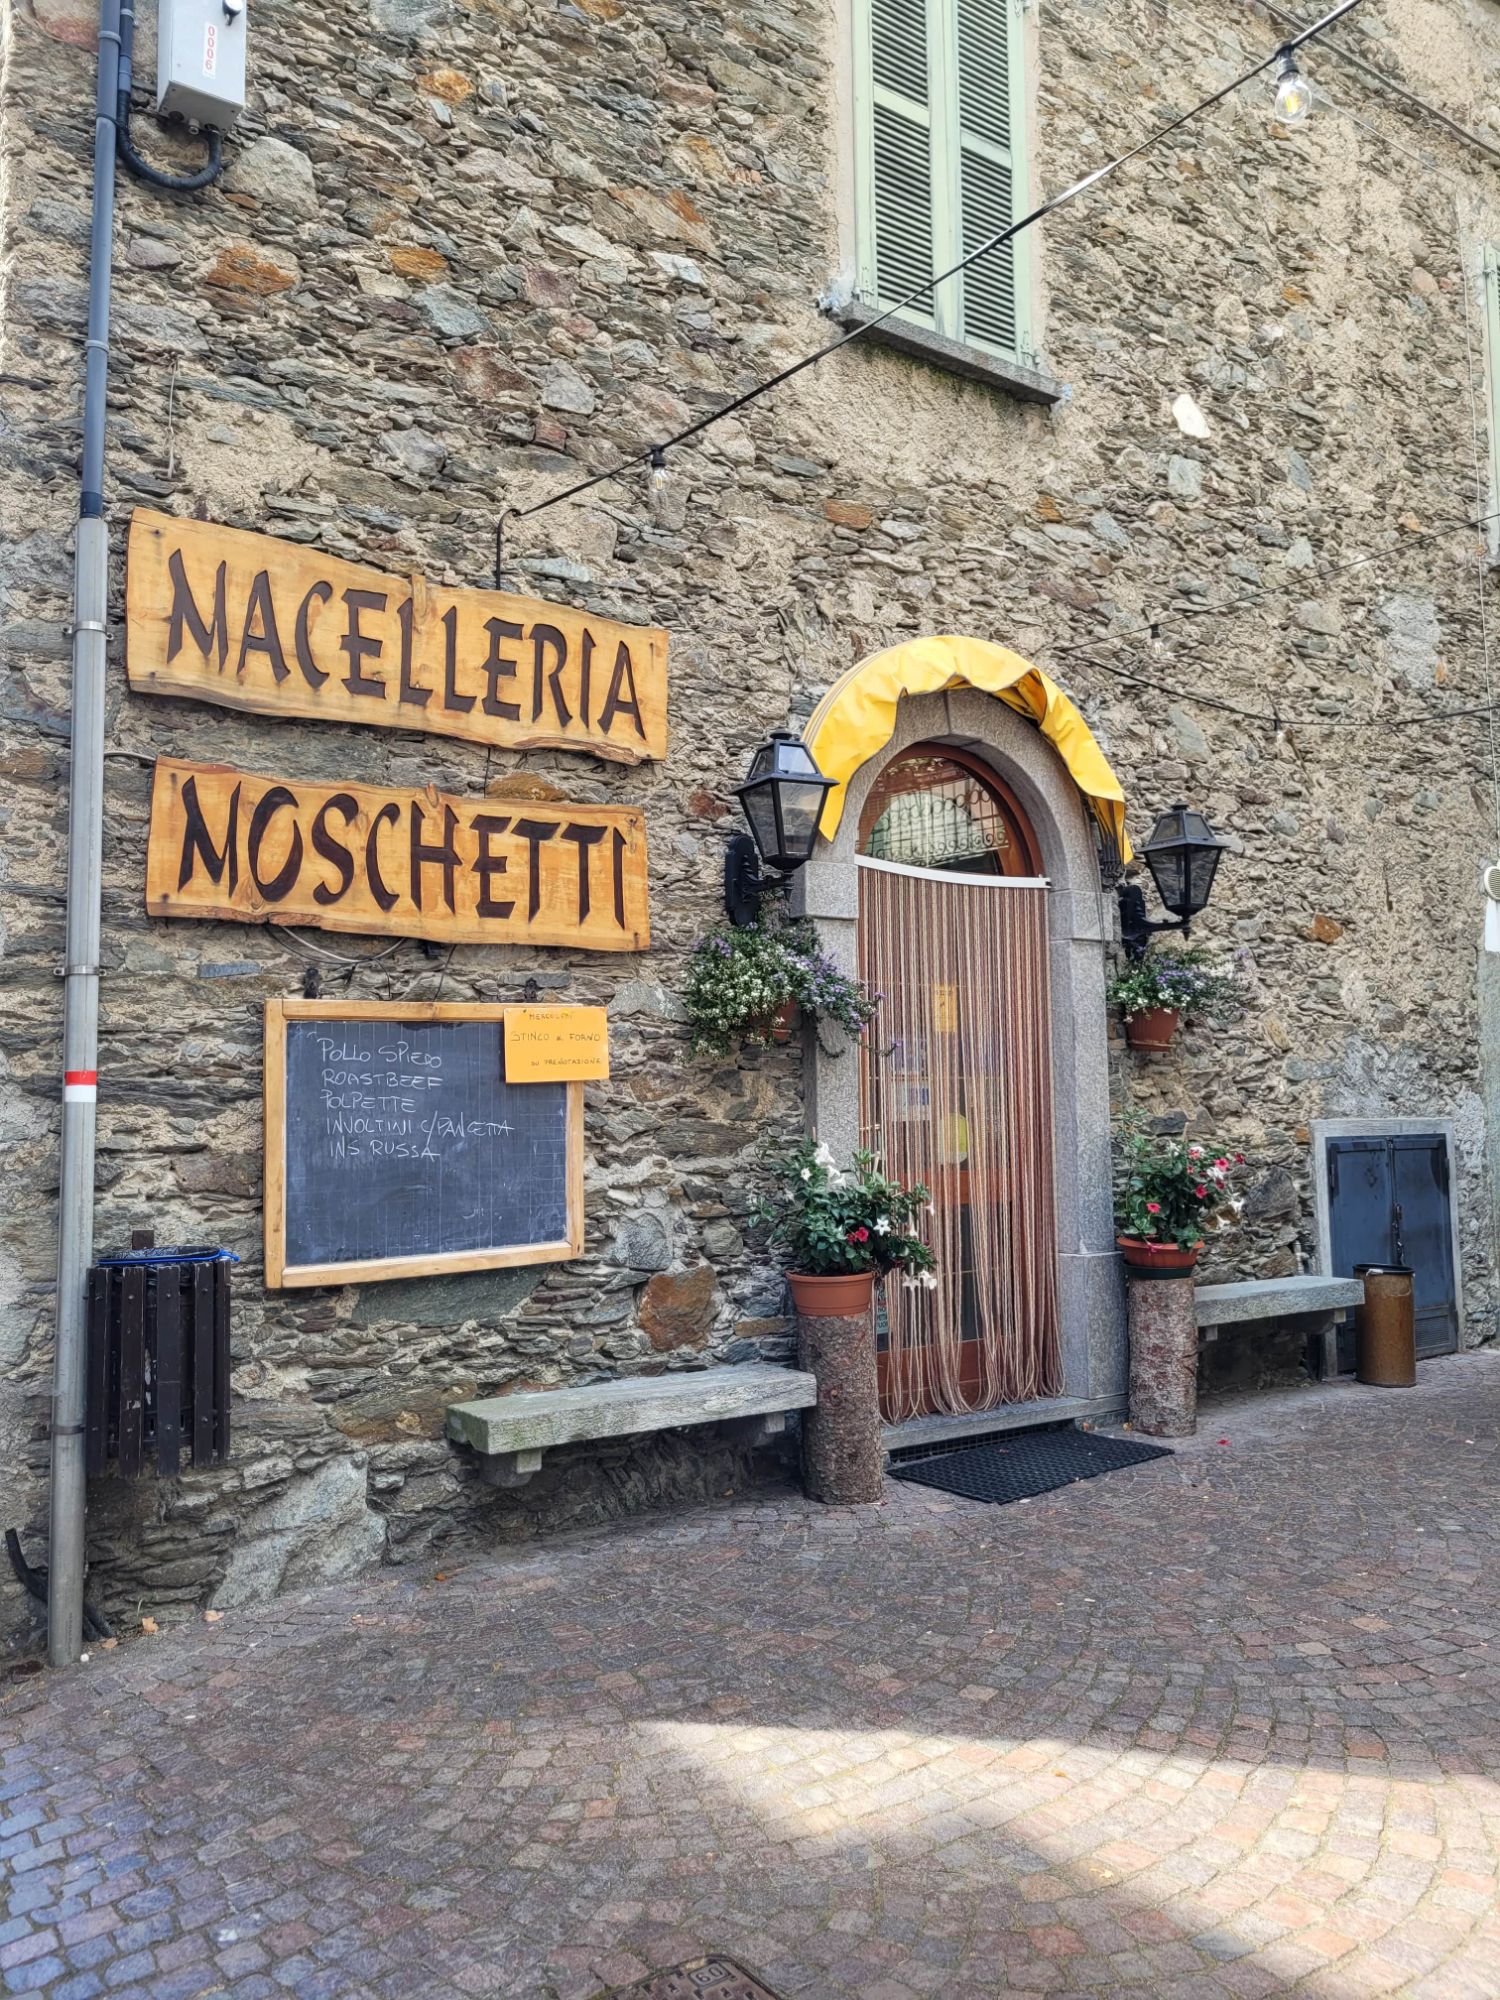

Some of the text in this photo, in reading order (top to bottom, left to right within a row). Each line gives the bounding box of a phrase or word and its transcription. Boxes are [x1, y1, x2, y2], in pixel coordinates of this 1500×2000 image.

[205, 26, 216, 71] 0006
[166, 547, 648, 740] MACELLERIA
[176, 775, 629, 930] MOSCHETTI
[510, 1031, 550, 1042] STINCO
[569, 1032, 601, 1042] FORNO
[317, 1037, 442, 1069] POLLO SPIEDO
[321, 1068, 444, 1090] ROASTBEEF
[320, 1088, 417, 1113] POLPETTE
[326, 1111, 412, 1136] INVOLTINI
[330, 1136, 441, 1163] INS RUSSA
